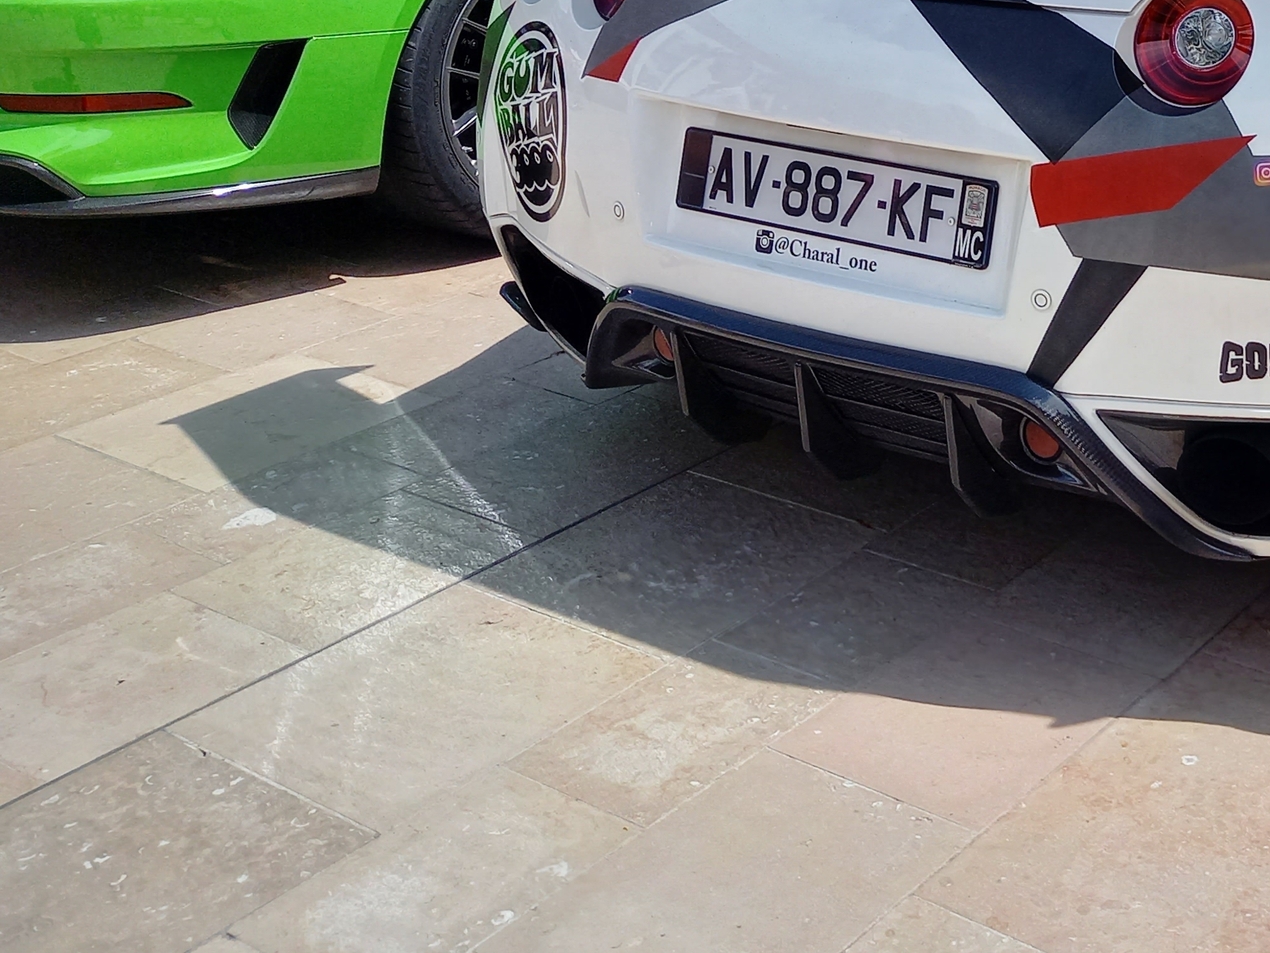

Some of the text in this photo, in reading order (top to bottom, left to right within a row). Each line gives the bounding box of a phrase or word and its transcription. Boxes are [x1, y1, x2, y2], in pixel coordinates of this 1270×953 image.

[501, 51, 557, 103] GUM
[500, 93, 558, 147] BALL
[709, 146, 955, 243] AV-887-KF
[774, 236, 878, 273] @Charal_one
[955, 227, 984, 261] MC
